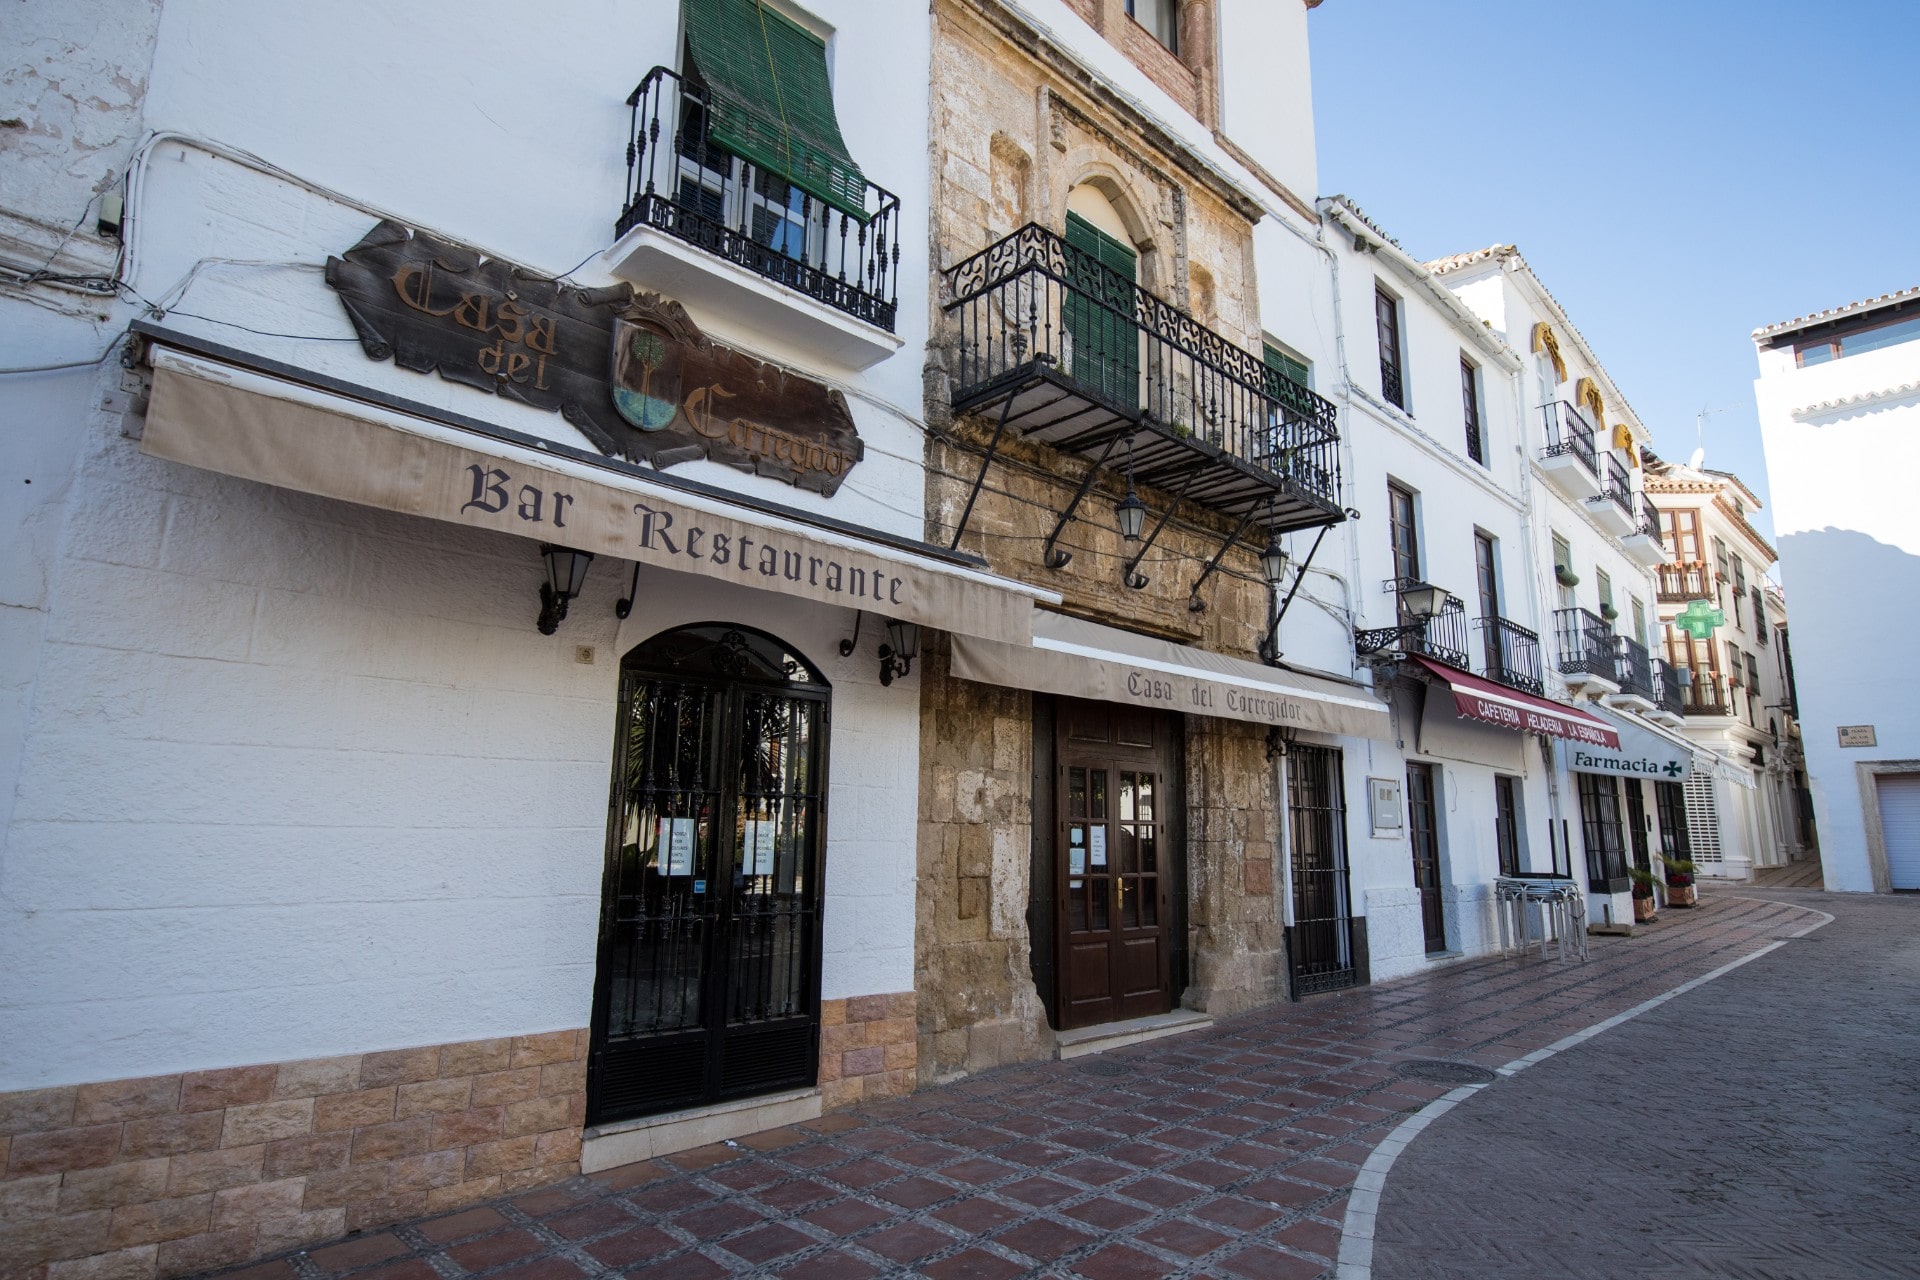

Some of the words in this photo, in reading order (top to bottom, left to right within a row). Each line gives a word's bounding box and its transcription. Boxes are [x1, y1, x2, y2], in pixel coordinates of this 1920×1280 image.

[392, 257, 558, 356] Casa
[478, 338, 550, 392] del
[683, 383, 851, 478] Corregidor
[461, 463, 573, 528] Bar
[634, 503, 904, 606] Restaurante
[1127, 671, 1173, 701] Casa
[1192, 683, 1213, 708] del
[1227, 689, 1300, 722] Corregidor
[1567, 723, 1579, 736] LA
[1575, 752, 1658, 773] Farmacia
